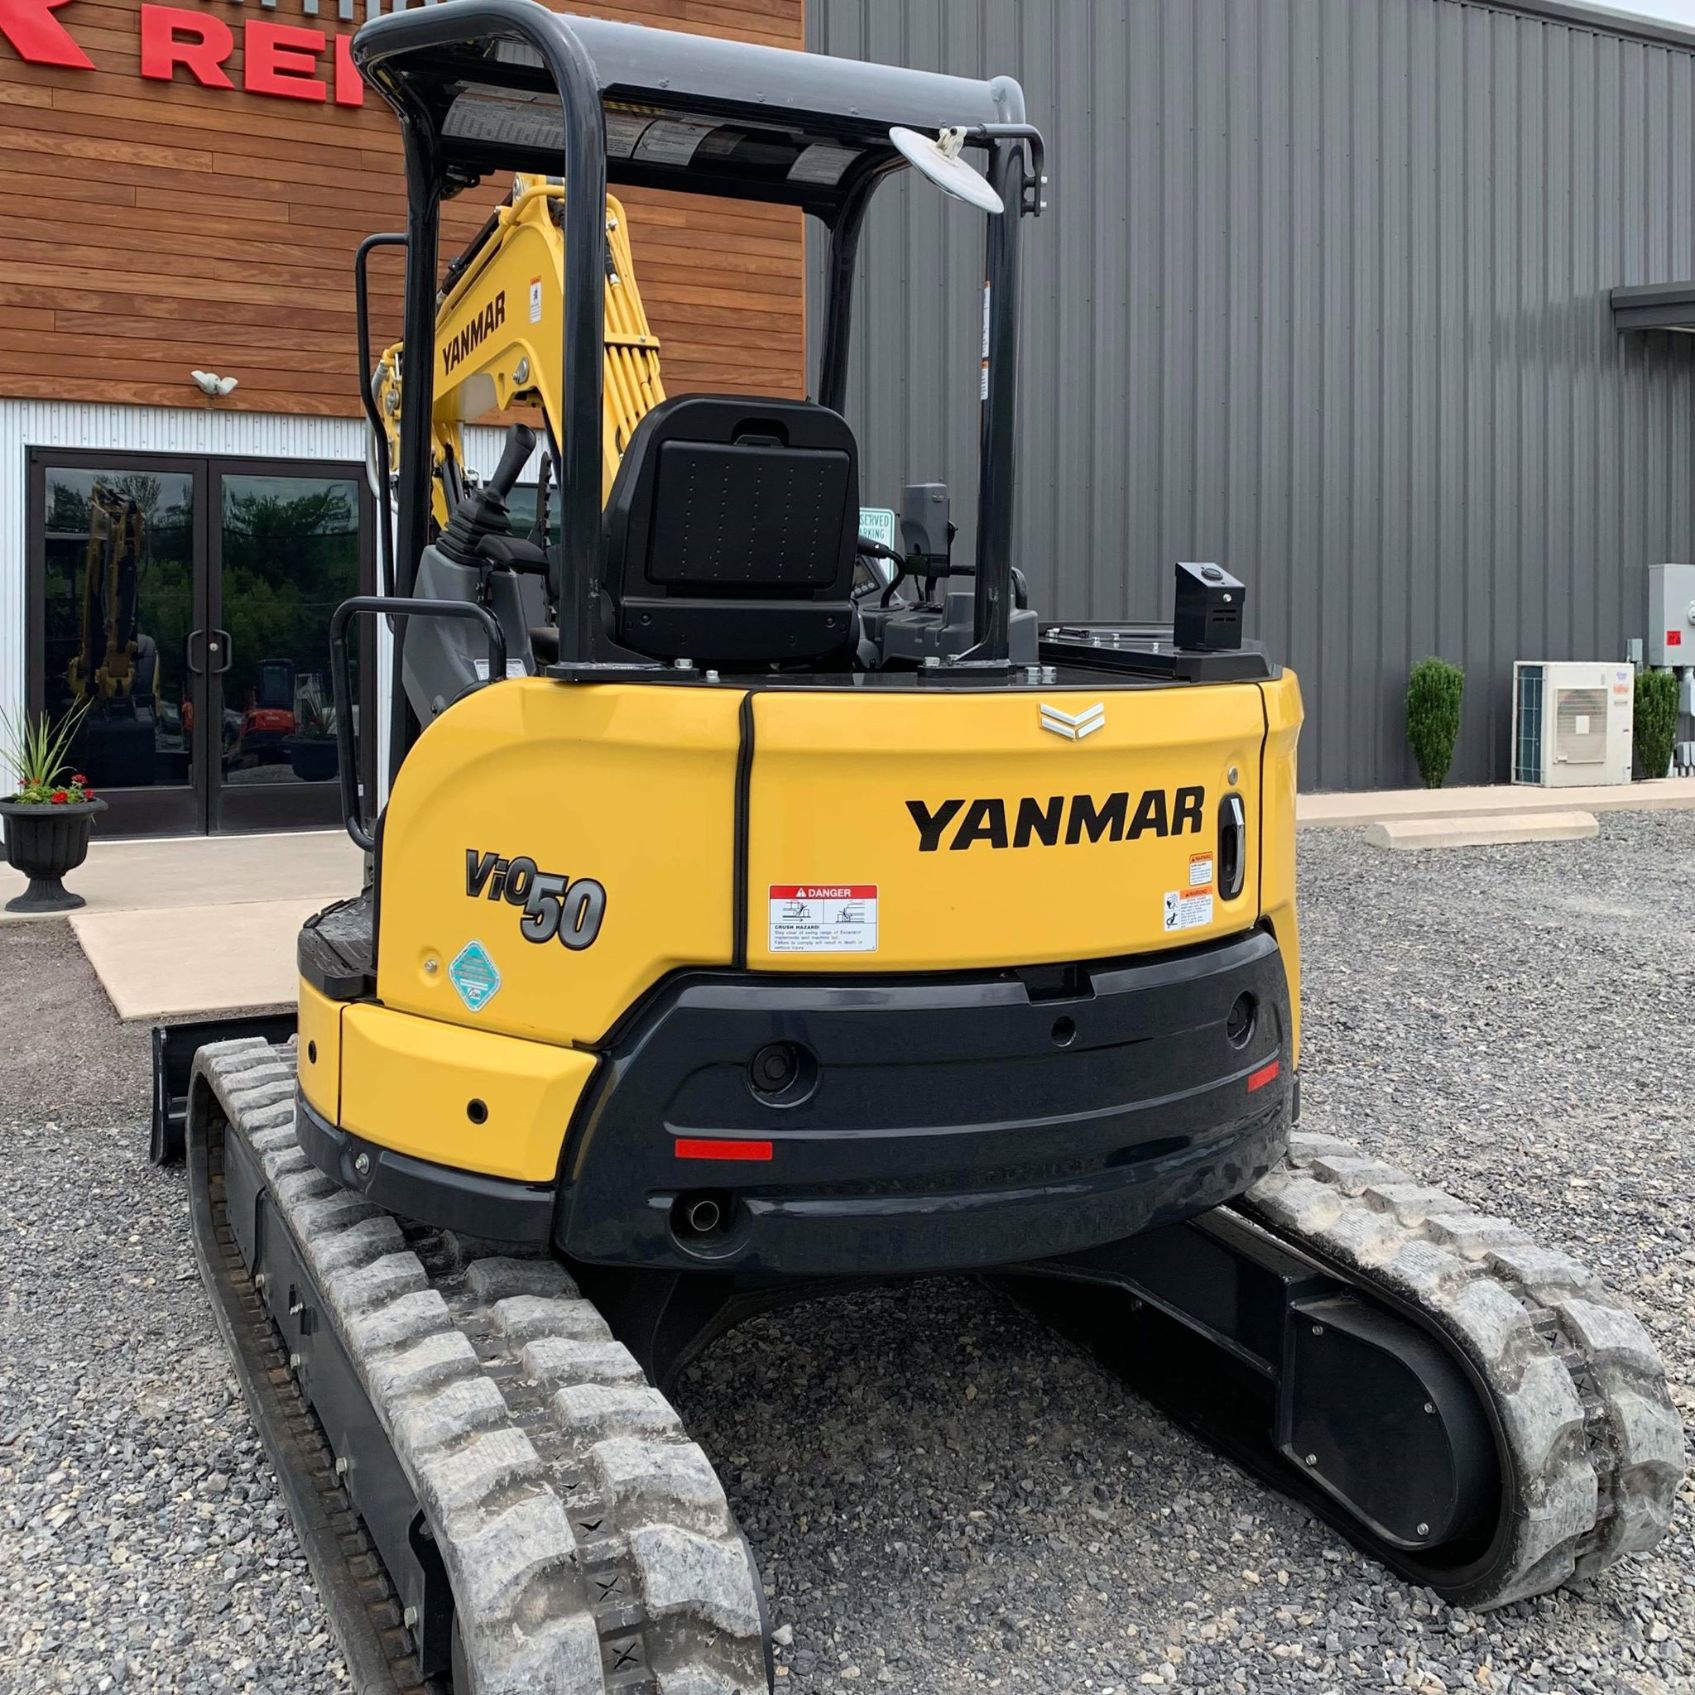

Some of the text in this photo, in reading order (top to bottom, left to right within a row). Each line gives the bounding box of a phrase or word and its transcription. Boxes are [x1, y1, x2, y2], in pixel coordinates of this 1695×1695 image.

[442, 290, 506, 376] YANMAR
[859, 514, 889, 527] SERVED
[905, 785, 1206, 852] YANMAR
[808, 888, 852, 898] DANGER
